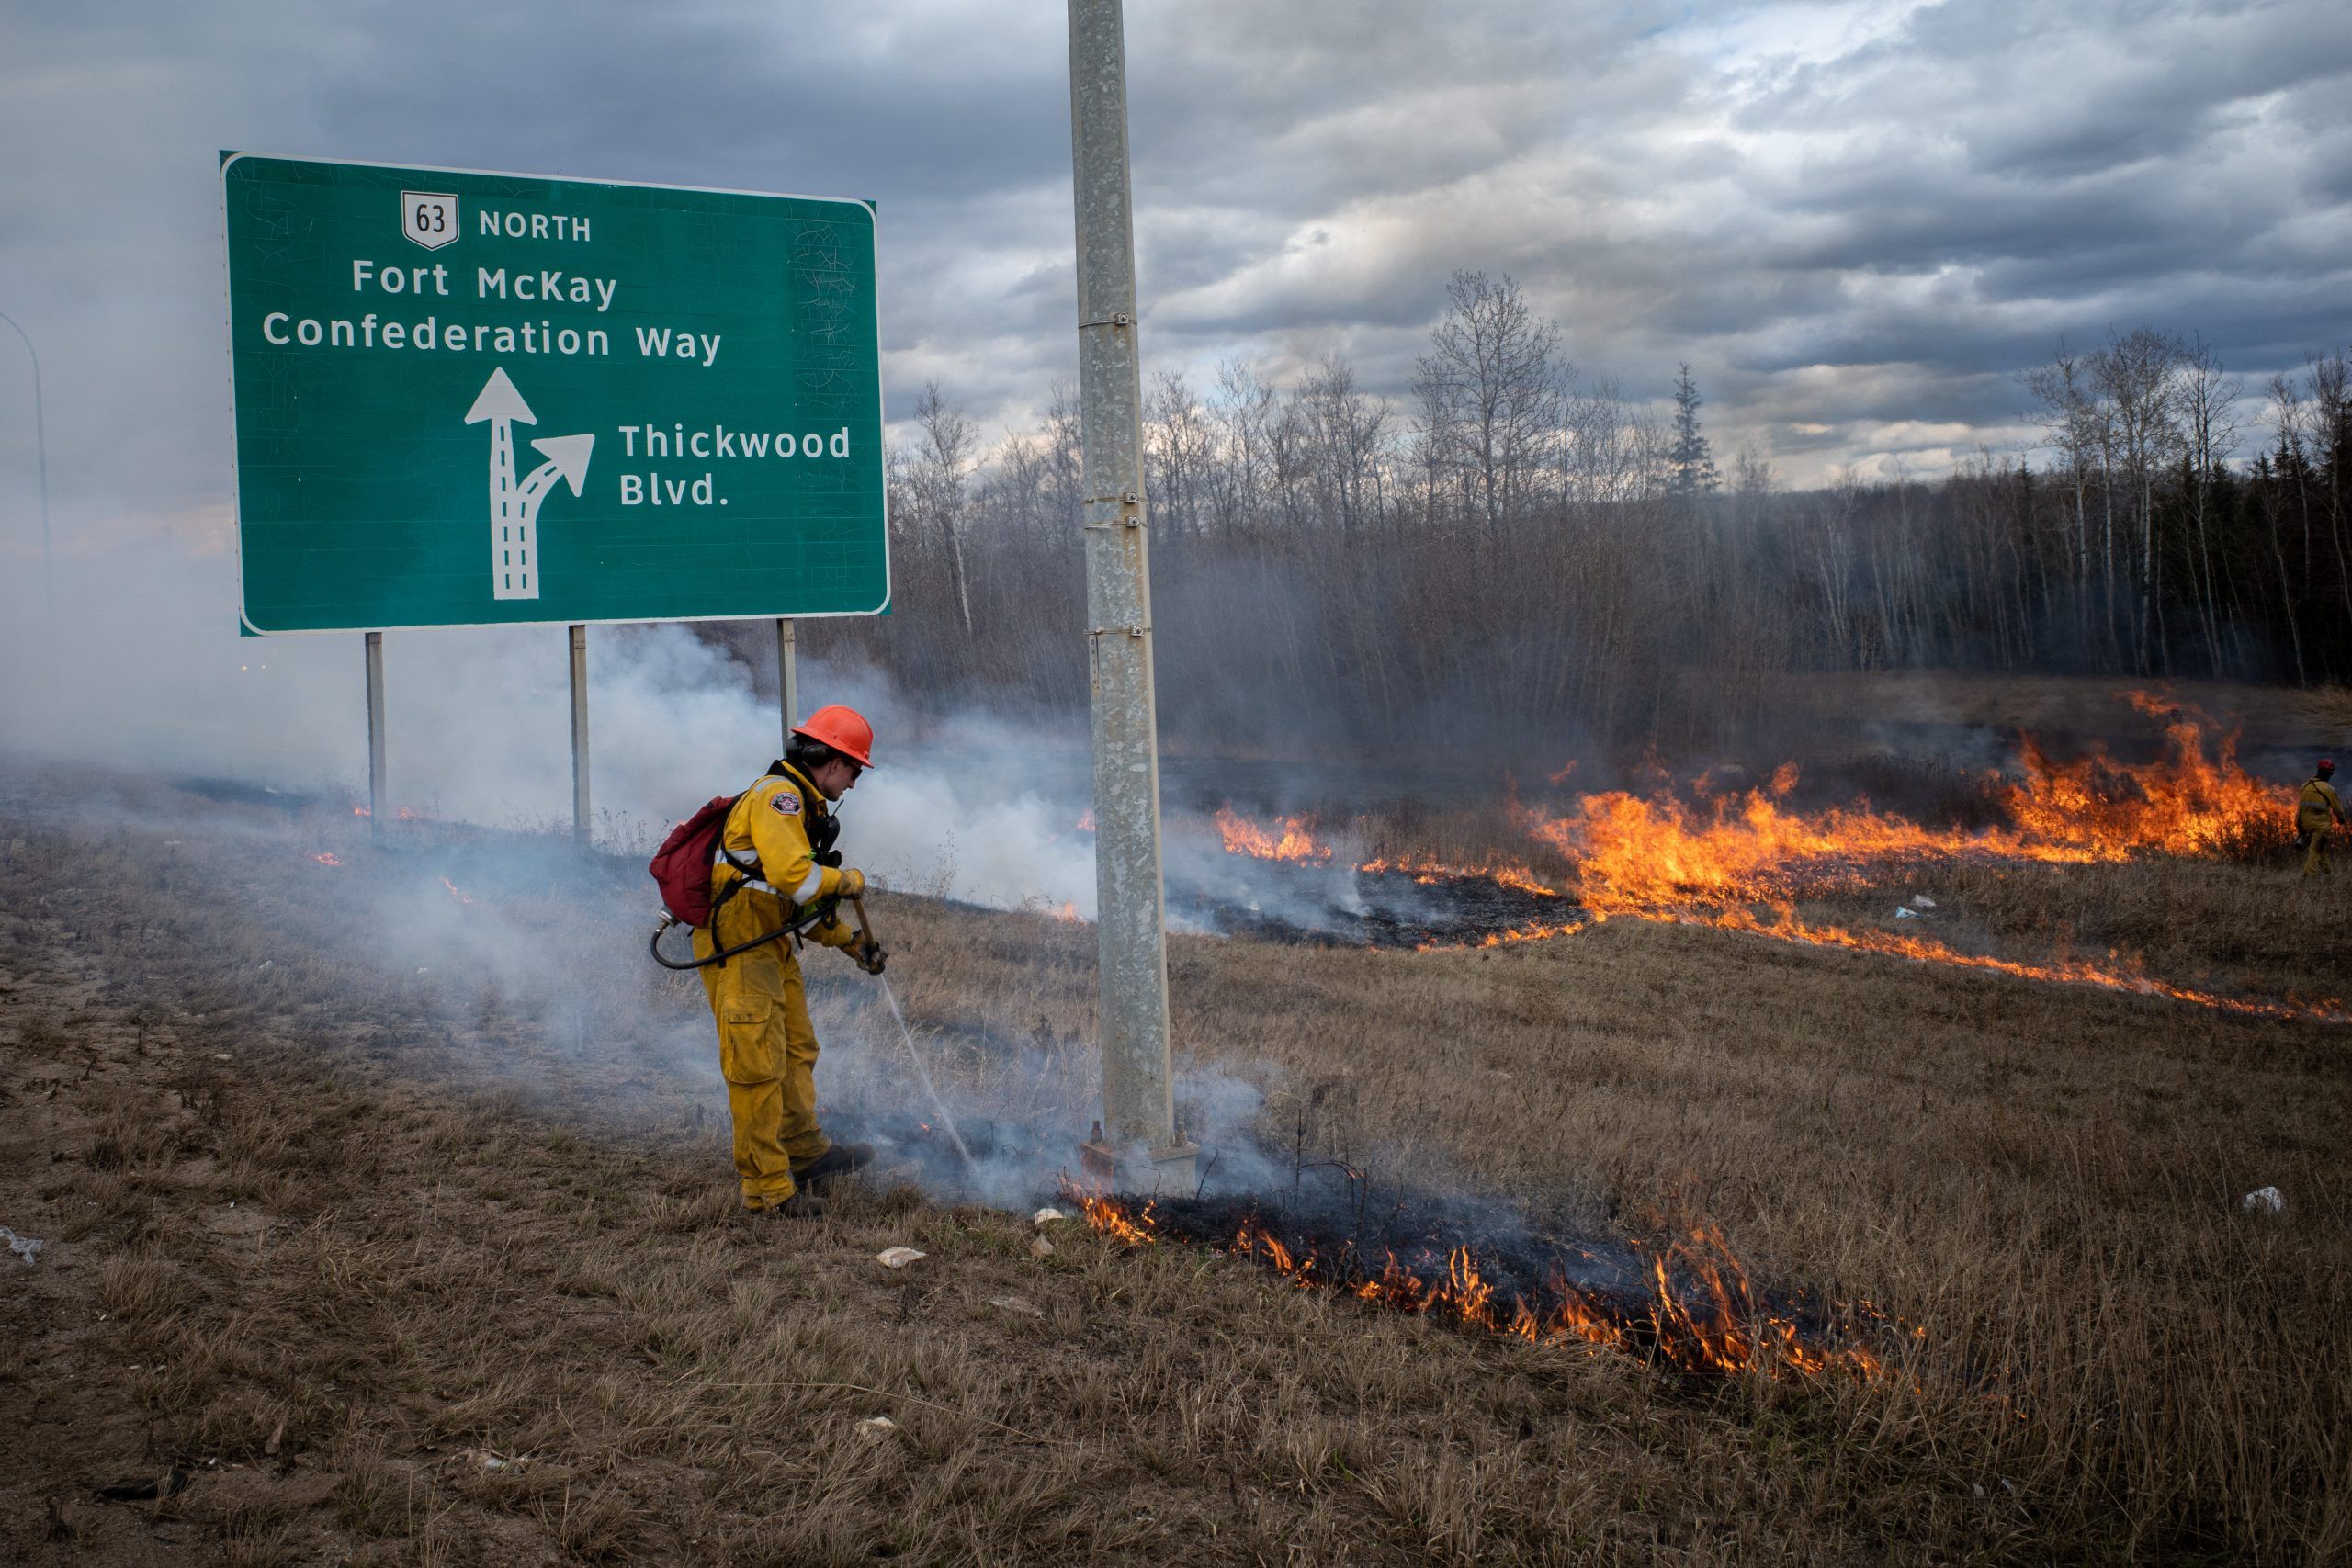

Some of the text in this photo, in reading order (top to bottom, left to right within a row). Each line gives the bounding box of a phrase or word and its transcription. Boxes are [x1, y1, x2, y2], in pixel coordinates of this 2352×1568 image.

[416, 203, 591, 242] 63 NORTH
[353, 260, 617, 312] Fort McKay
[263, 312, 722, 367] Confederation Way
[618, 423, 850, 458] Thickwood
[620, 472, 729, 505] Blvd.
